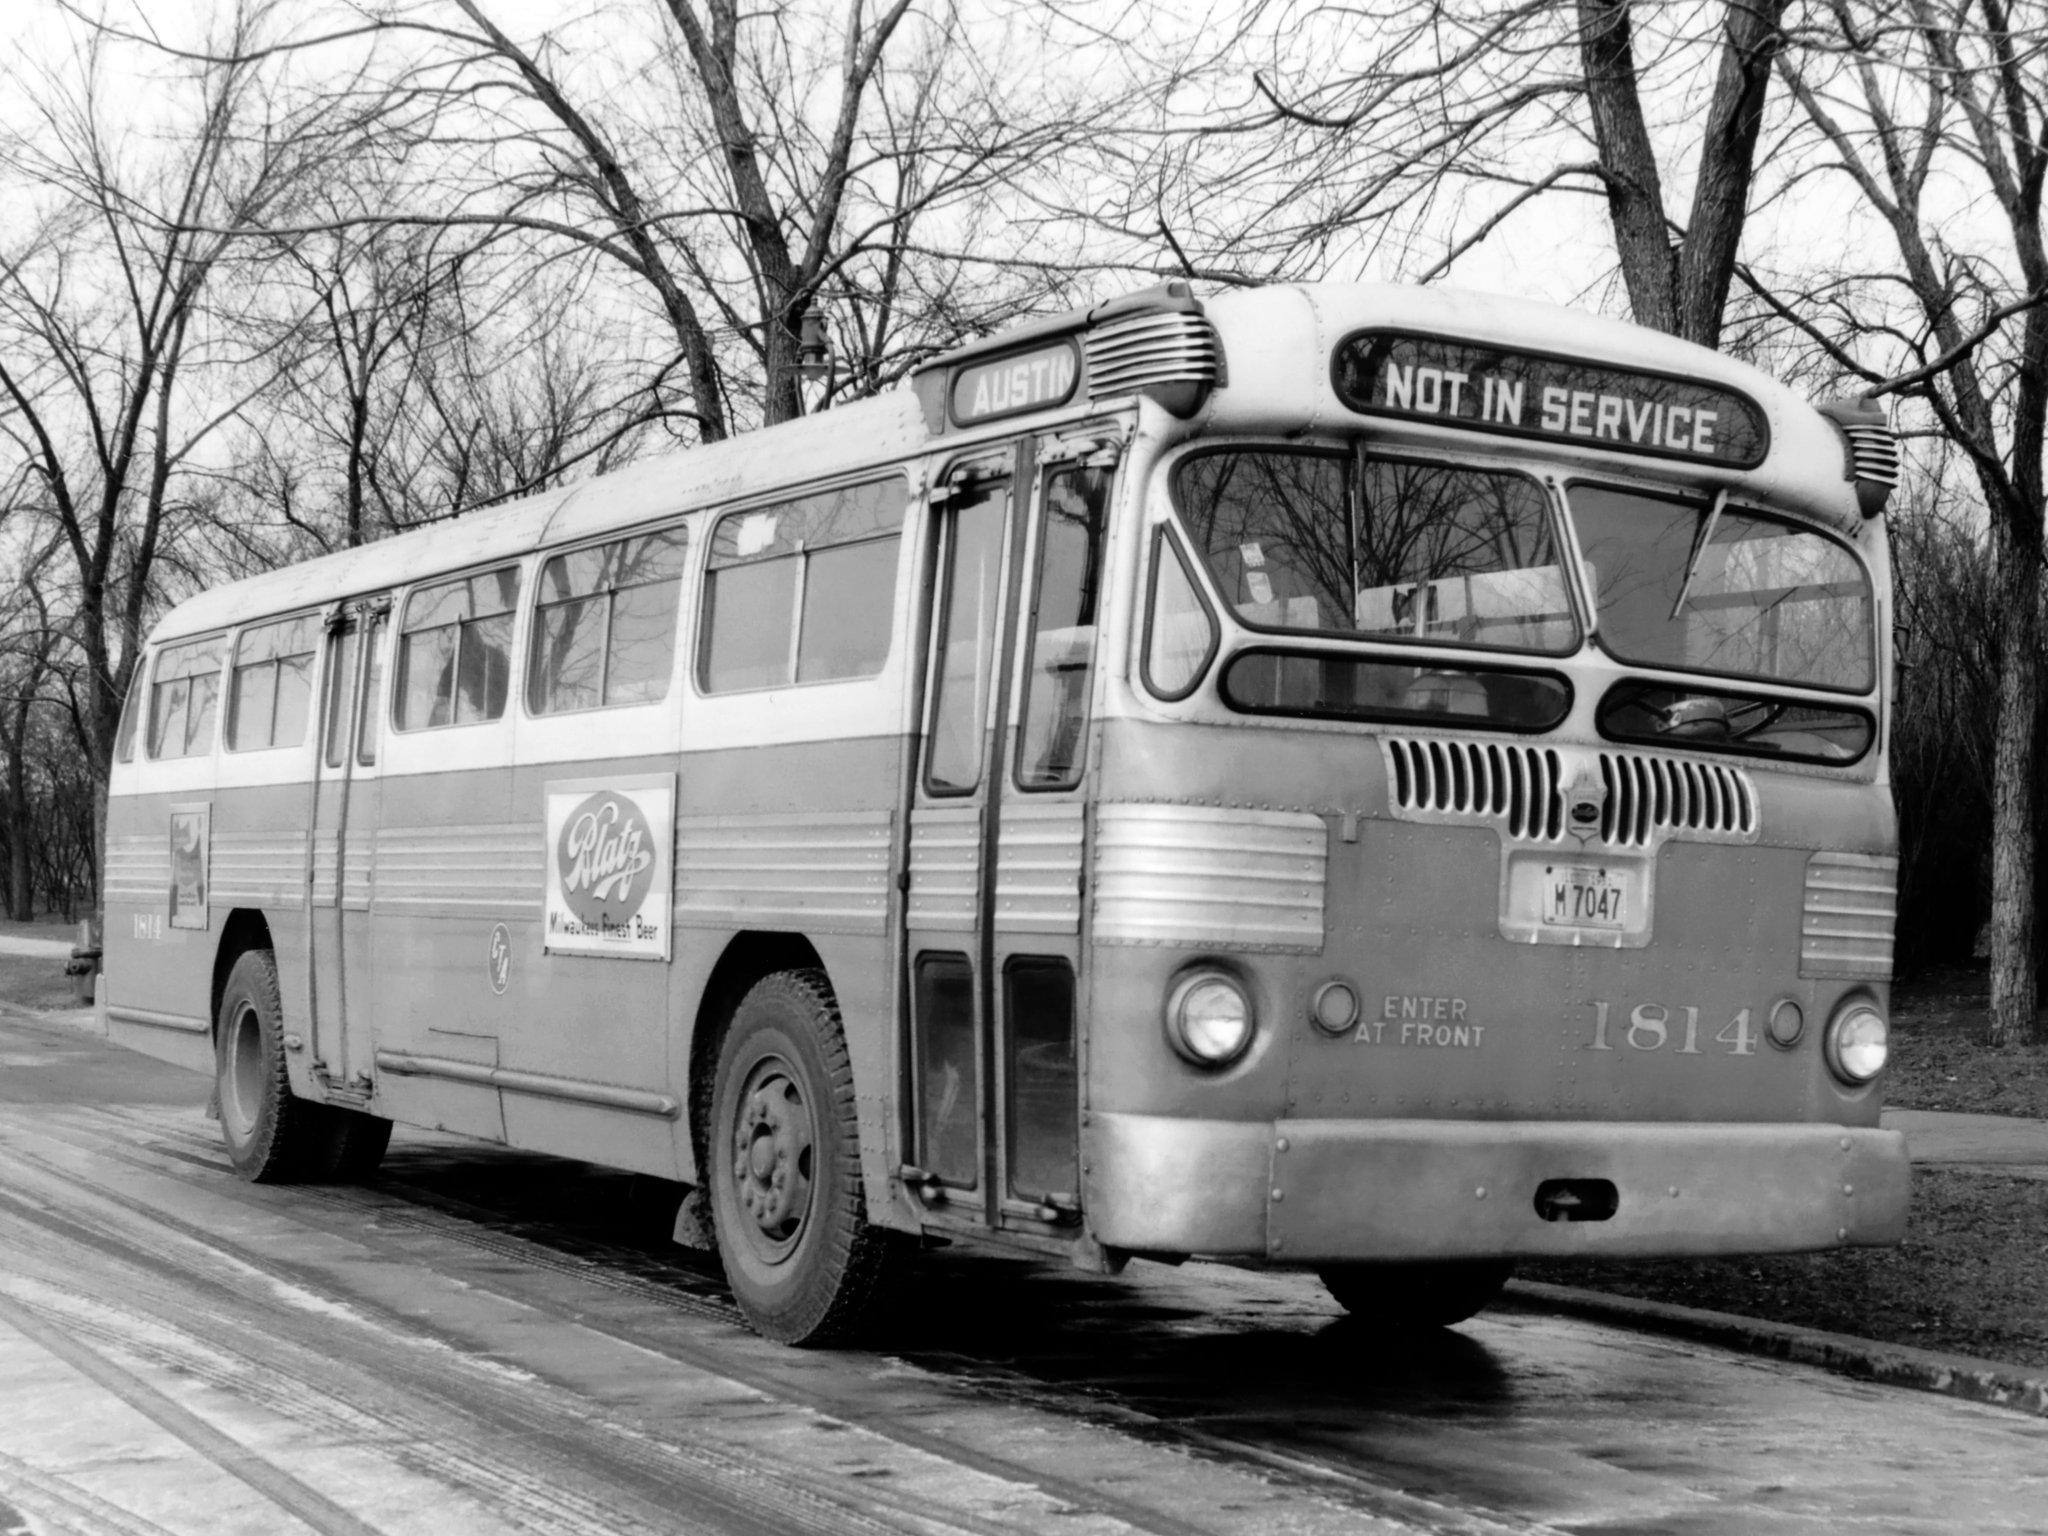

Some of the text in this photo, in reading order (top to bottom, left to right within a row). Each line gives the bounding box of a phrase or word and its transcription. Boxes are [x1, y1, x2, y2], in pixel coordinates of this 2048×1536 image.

[972, 354, 1075, 417] AUSTIN
[1386, 363, 1717, 453] NOT IN SERVICE
[565, 801, 650, 902] Blatz
[1554, 883, 1621, 920] M 7047
[133, 912, 162, 940] 1814
[603, 912, 631, 938] Finest
[636, 914, 658, 940] Beer
[1384, 996, 1467, 1020] ENTER
[1354, 1022, 1485, 1047] AT FRONT
[1584, 1001, 1758, 1056] 1814
